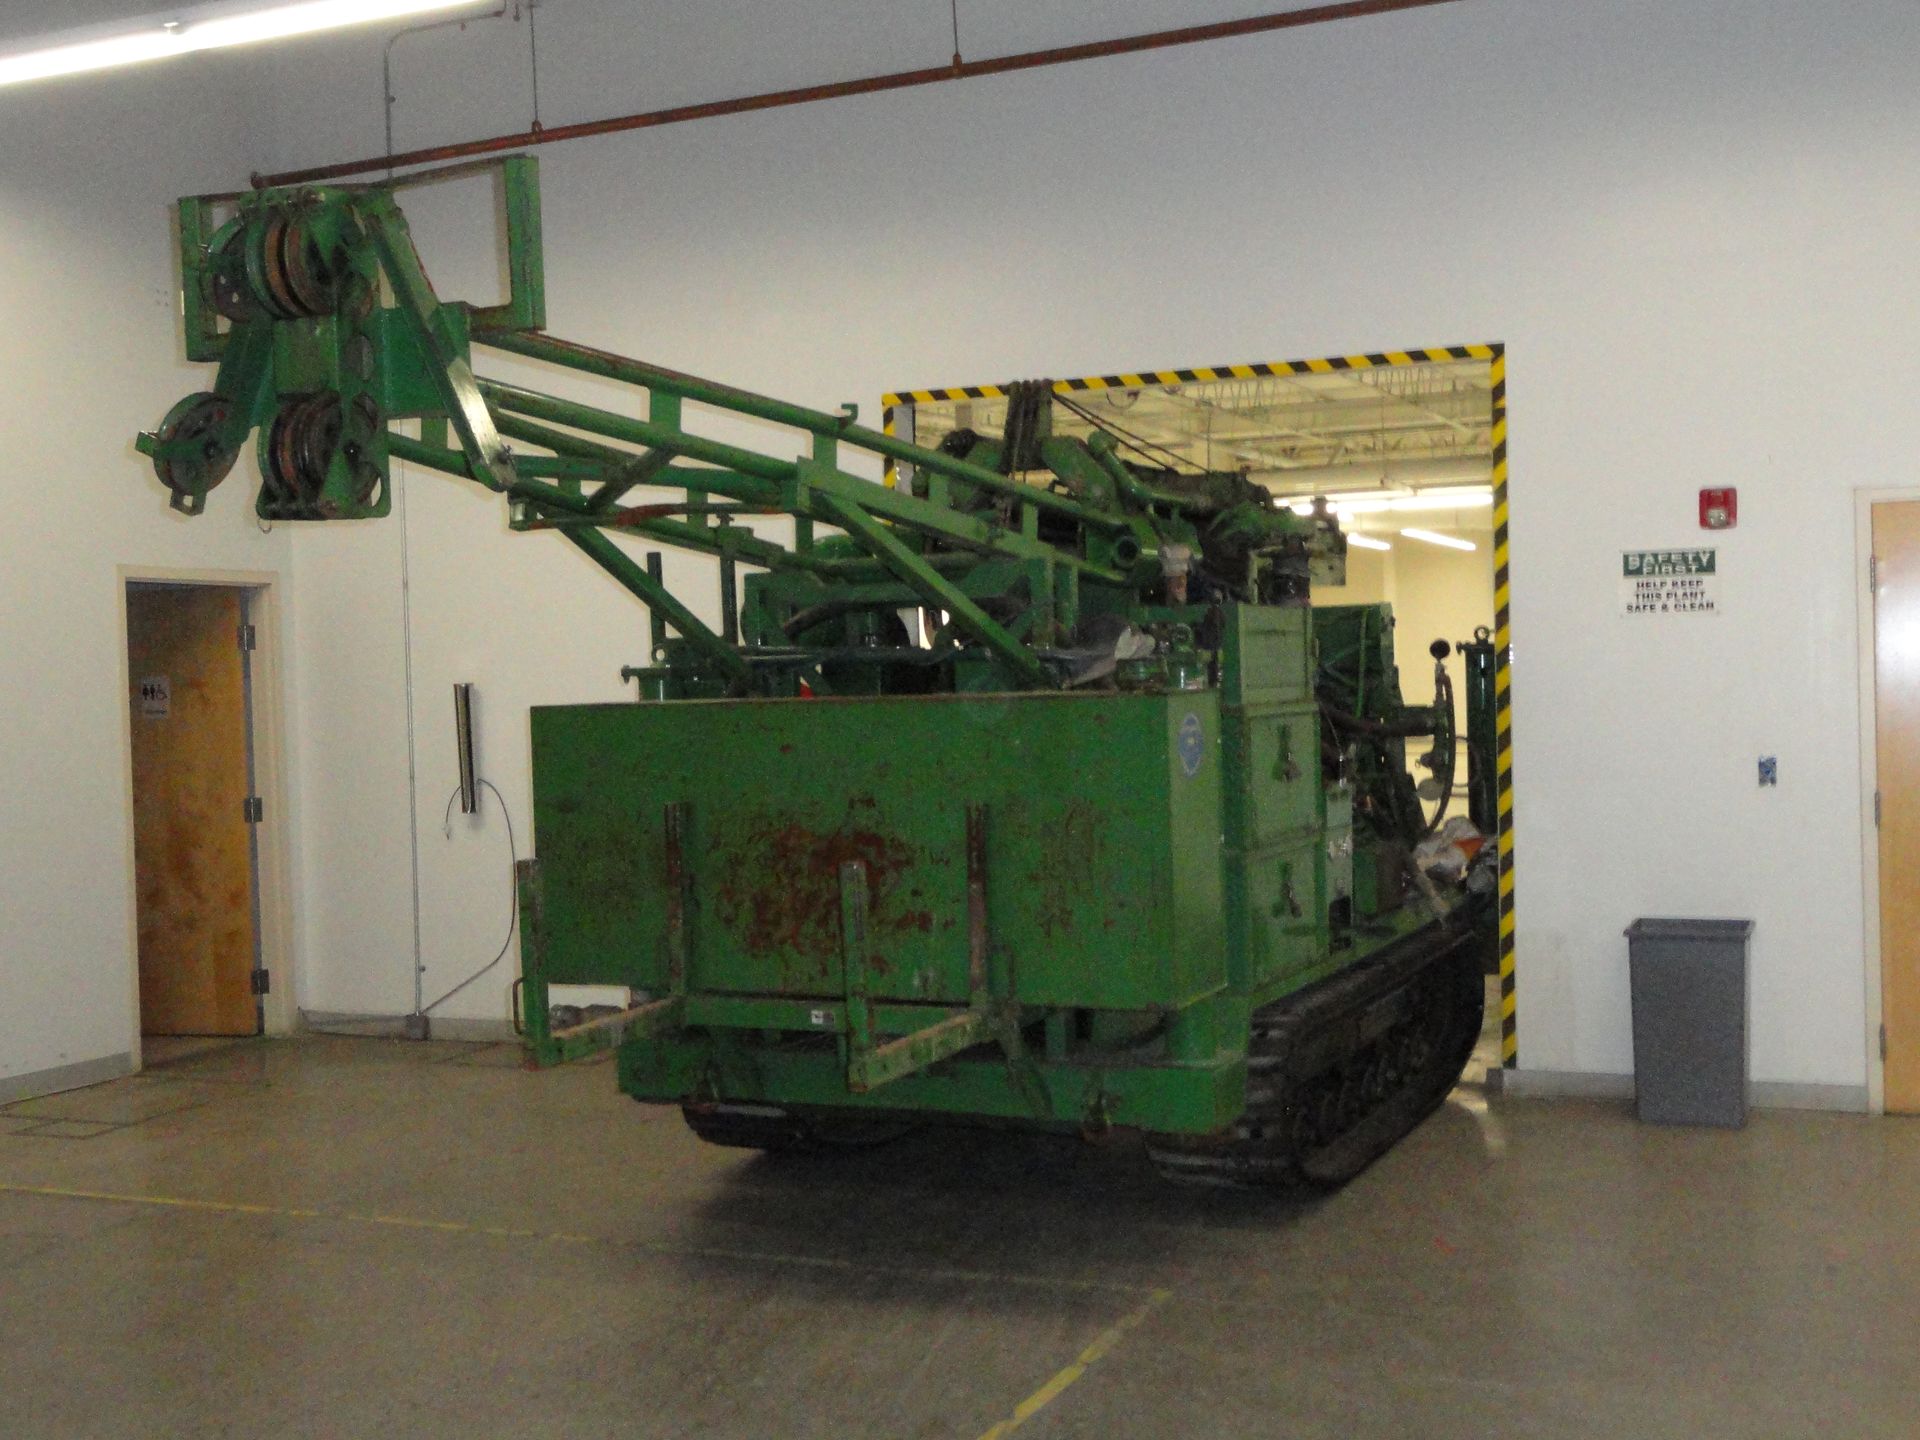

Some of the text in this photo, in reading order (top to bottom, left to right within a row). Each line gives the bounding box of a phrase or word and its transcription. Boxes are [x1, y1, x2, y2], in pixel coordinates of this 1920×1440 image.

[1636, 580, 1704, 590] HELP KEEP
[1635, 593, 1662, 602] THIS
[1626, 604, 1656, 613] SAFE
[1674, 602, 1715, 611] CLEAN
